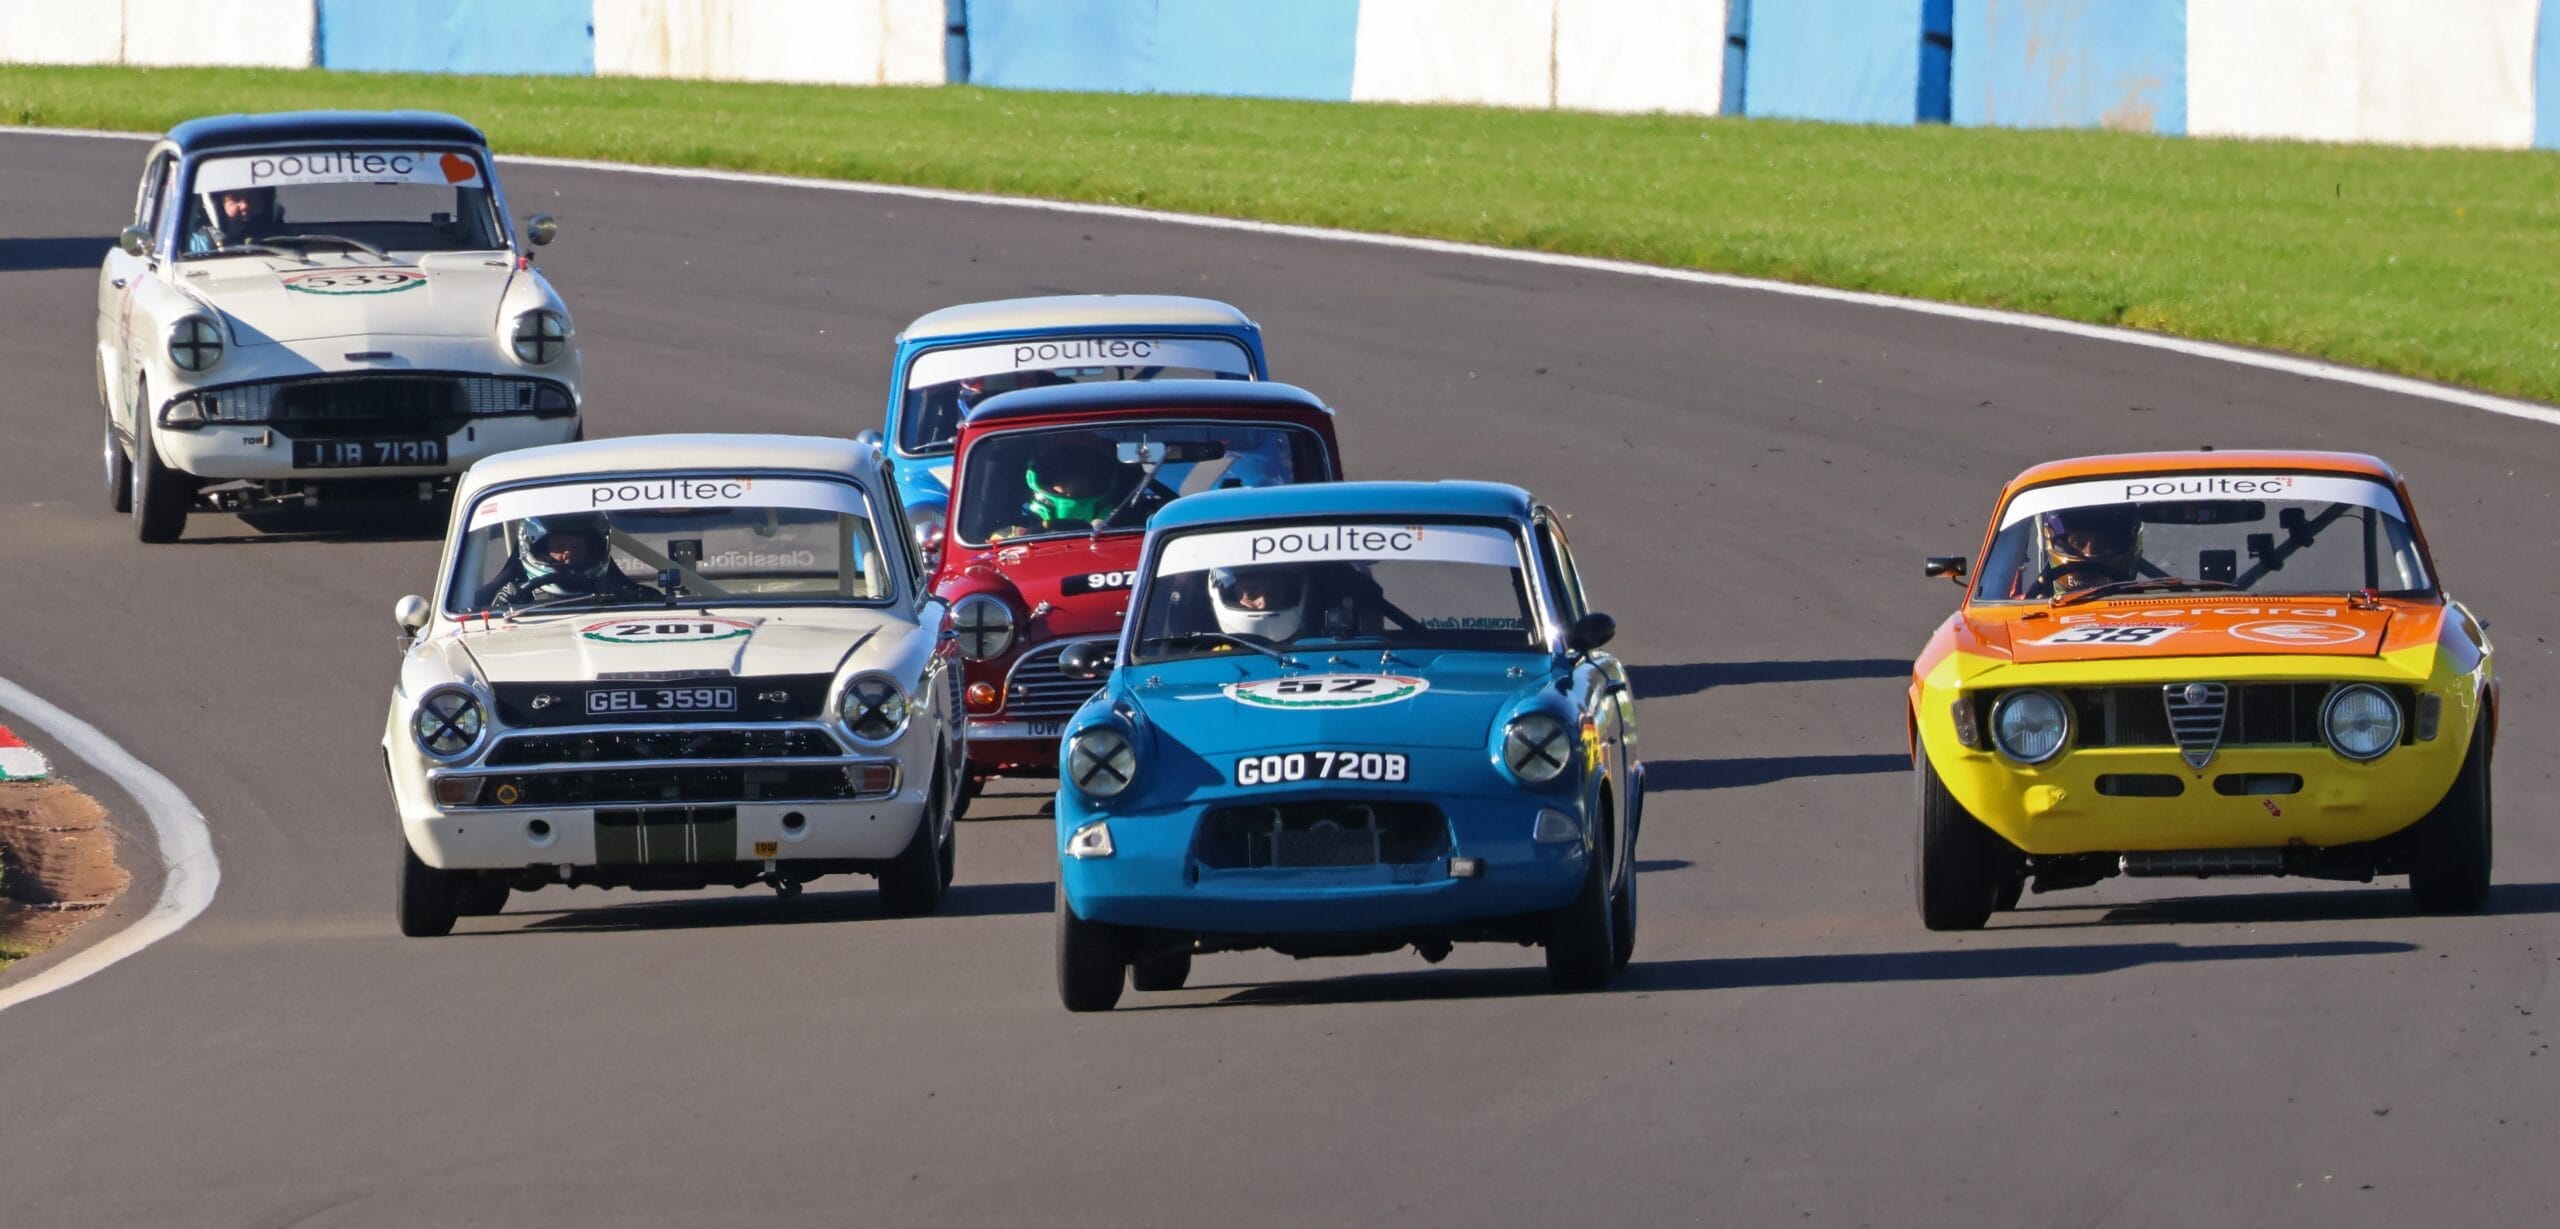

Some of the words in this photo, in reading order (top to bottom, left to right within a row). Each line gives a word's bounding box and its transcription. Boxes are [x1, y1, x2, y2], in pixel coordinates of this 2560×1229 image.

[250, 151, 413, 184] poultec
[307, 274, 409, 288] 539
[1015, 338, 1152, 368] poultec
[375, 441, 437, 464] 713D
[591, 480, 742, 508] poultec
[2126, 478, 2283, 500] poultec
[1252, 526, 1413, 561] poultec
[2059, 607, 2337, 624] Everard
[615, 623, 715, 636] 201
[2052, 627, 2168, 643] 38
[1276, 678, 1376, 694] 52
[589, 692, 648, 712] GEL
[656, 688, 733, 709] 359D
[1026, 721, 1061, 736] TOW
[1238, 753, 1305, 786] GOO
[1315, 751, 1406, 781] 720B
